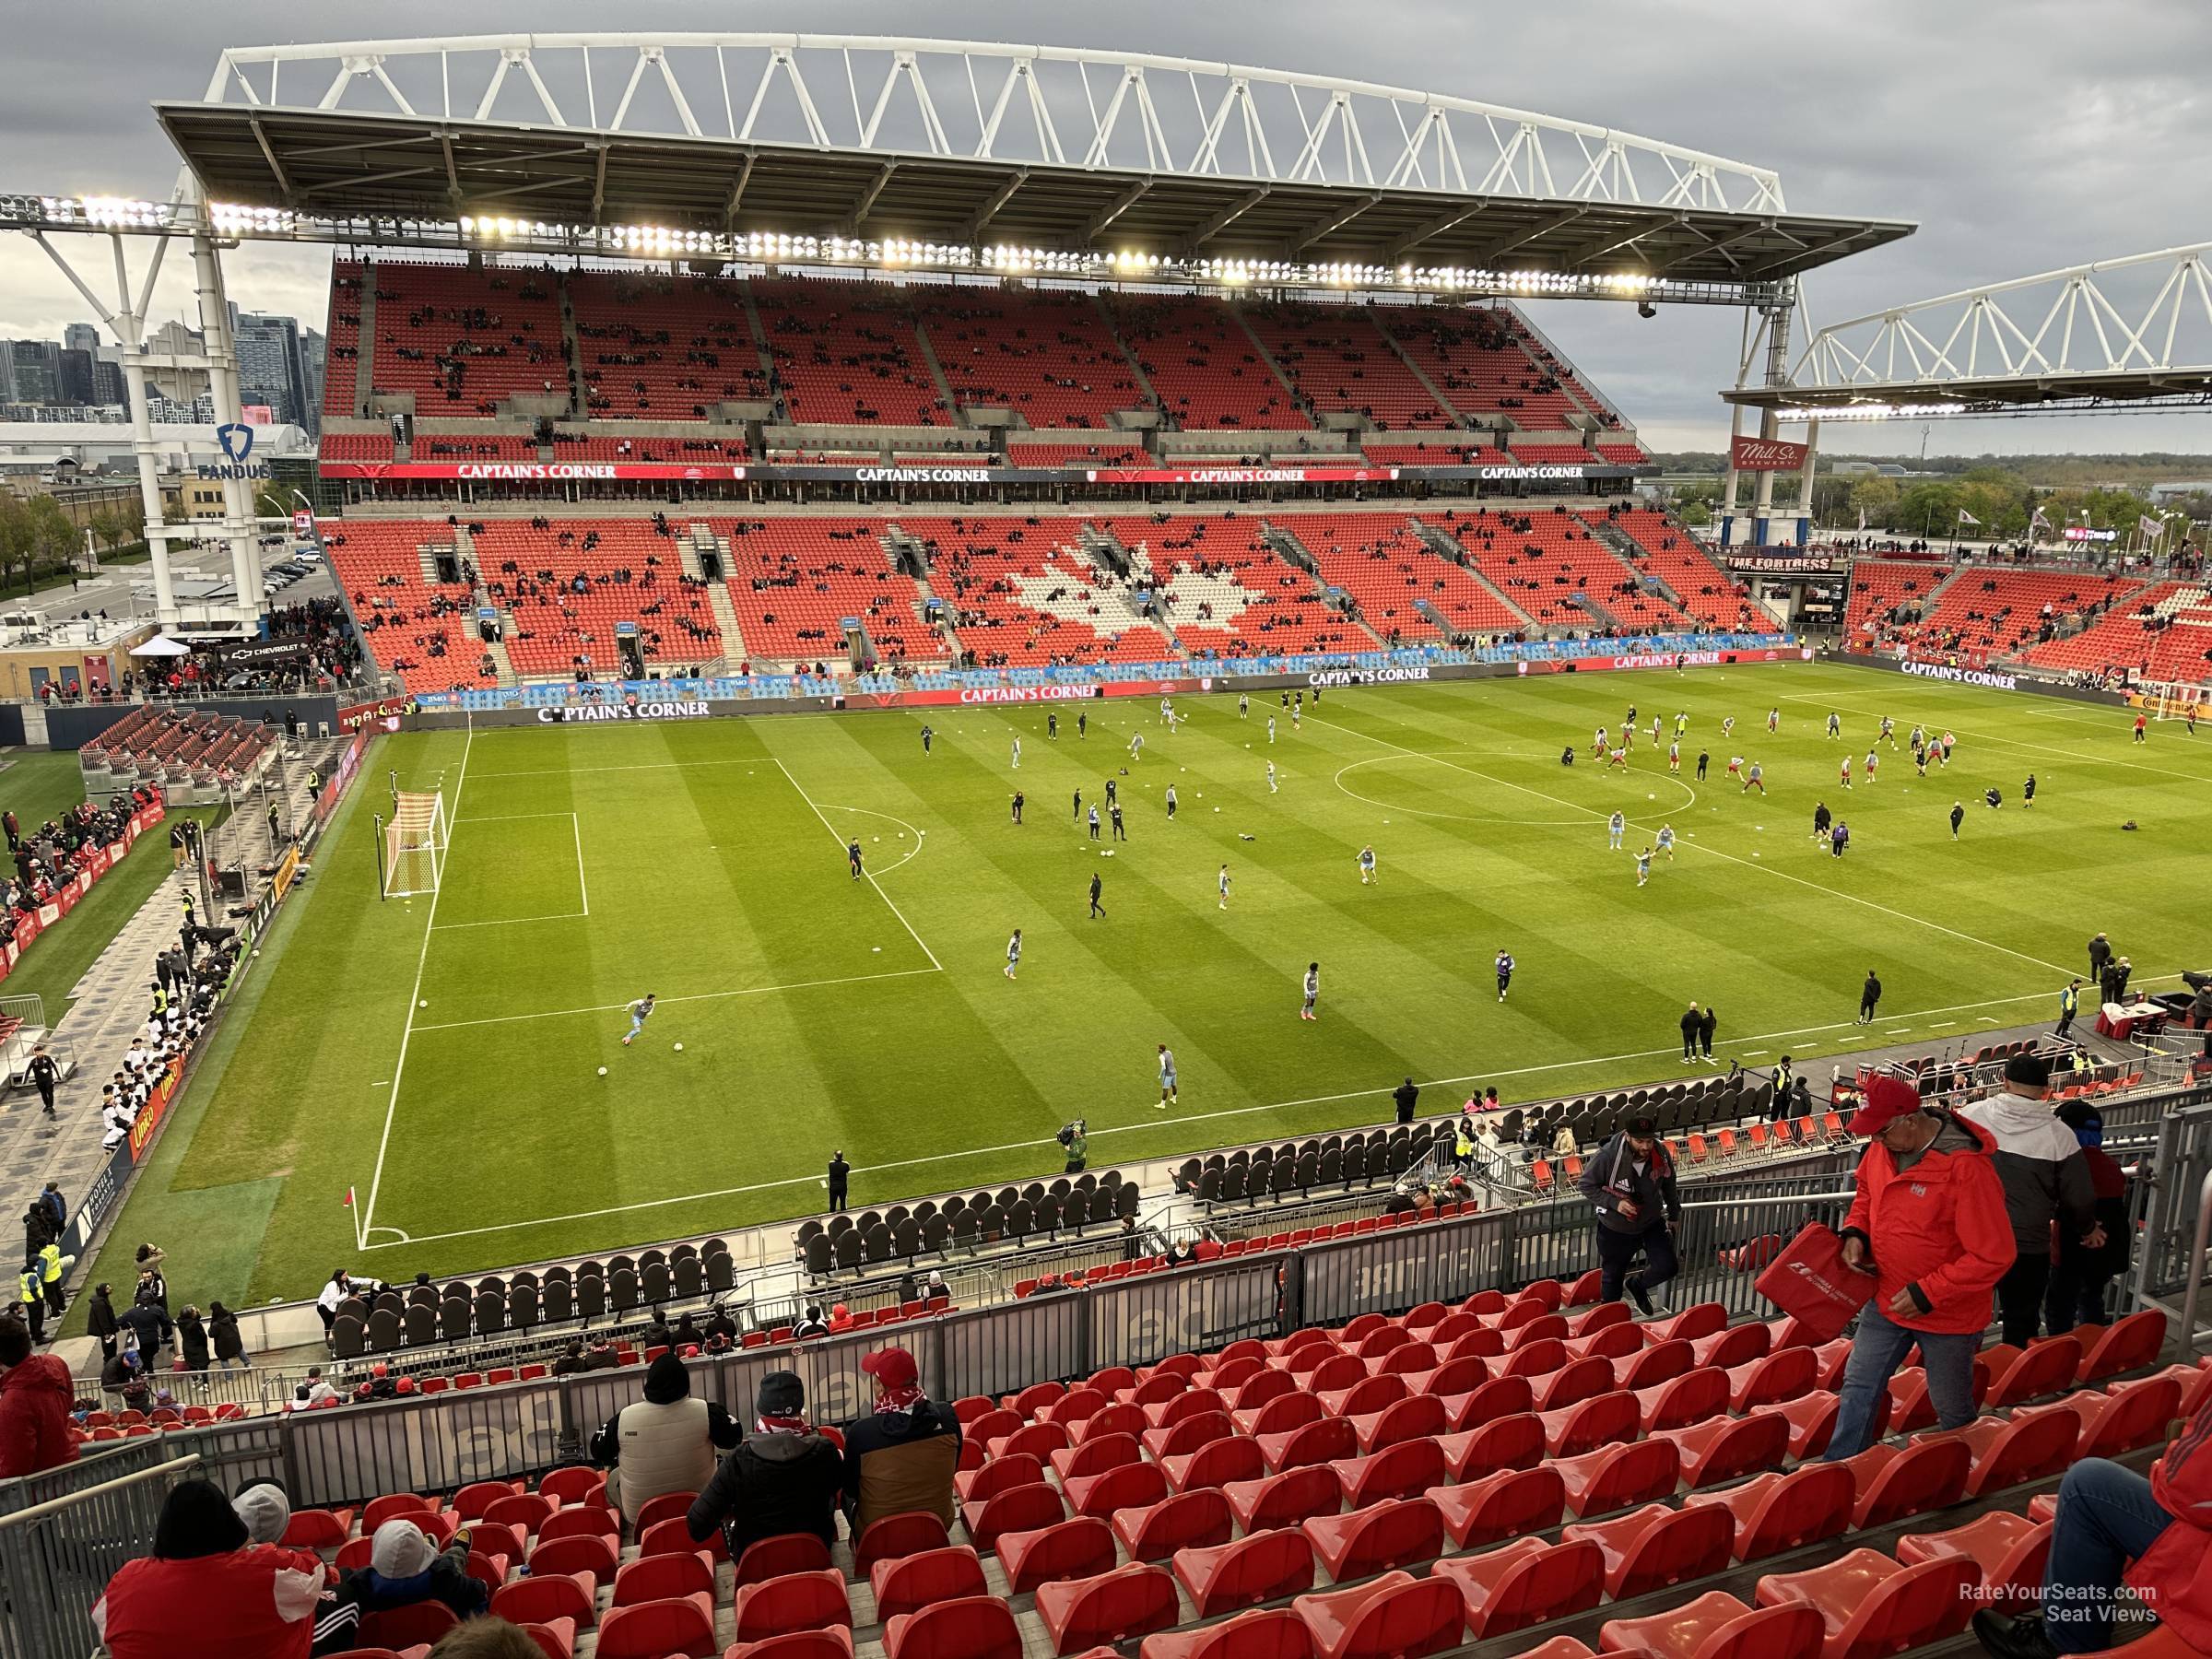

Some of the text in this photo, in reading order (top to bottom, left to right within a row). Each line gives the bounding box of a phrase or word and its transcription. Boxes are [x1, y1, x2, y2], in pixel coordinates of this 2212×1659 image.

[1738, 442, 1798, 460] Mill St.
[197, 465, 280, 479] FANDUEL
[457, 465, 618, 479] CAPTAIN'S CORNER
[855, 468, 990, 482] CAPTAIN'S CORNER
[1190, 469, 1305, 482] CAPTAIN'S CORNER
[1481, 466, 1583, 479] CAPTAIN'S CORNER
[1728, 557, 1830, 570] THE FORTRESS
[254, 643, 299, 656] CHEVROLET
[1614, 652, 1720, 668] CAPTAIN'S CORNER
[1377, 667, 1430, 681] CORNER
[1900, 661, 2017, 690] CAPTAIN'S CORNER
[960, 687, 1038, 703] CAPTAIN'S
[636, 701, 710, 718] CORNER
[2142, 697, 2192, 712] Contnenta
[373, 707, 398, 719] FLD
[160, 1064, 178, 1101] Unico
[134, 1106, 154, 1148] Unico
[88, 1175, 108, 1206] HOTEL
[91, 1178, 115, 1217] TORONTO
